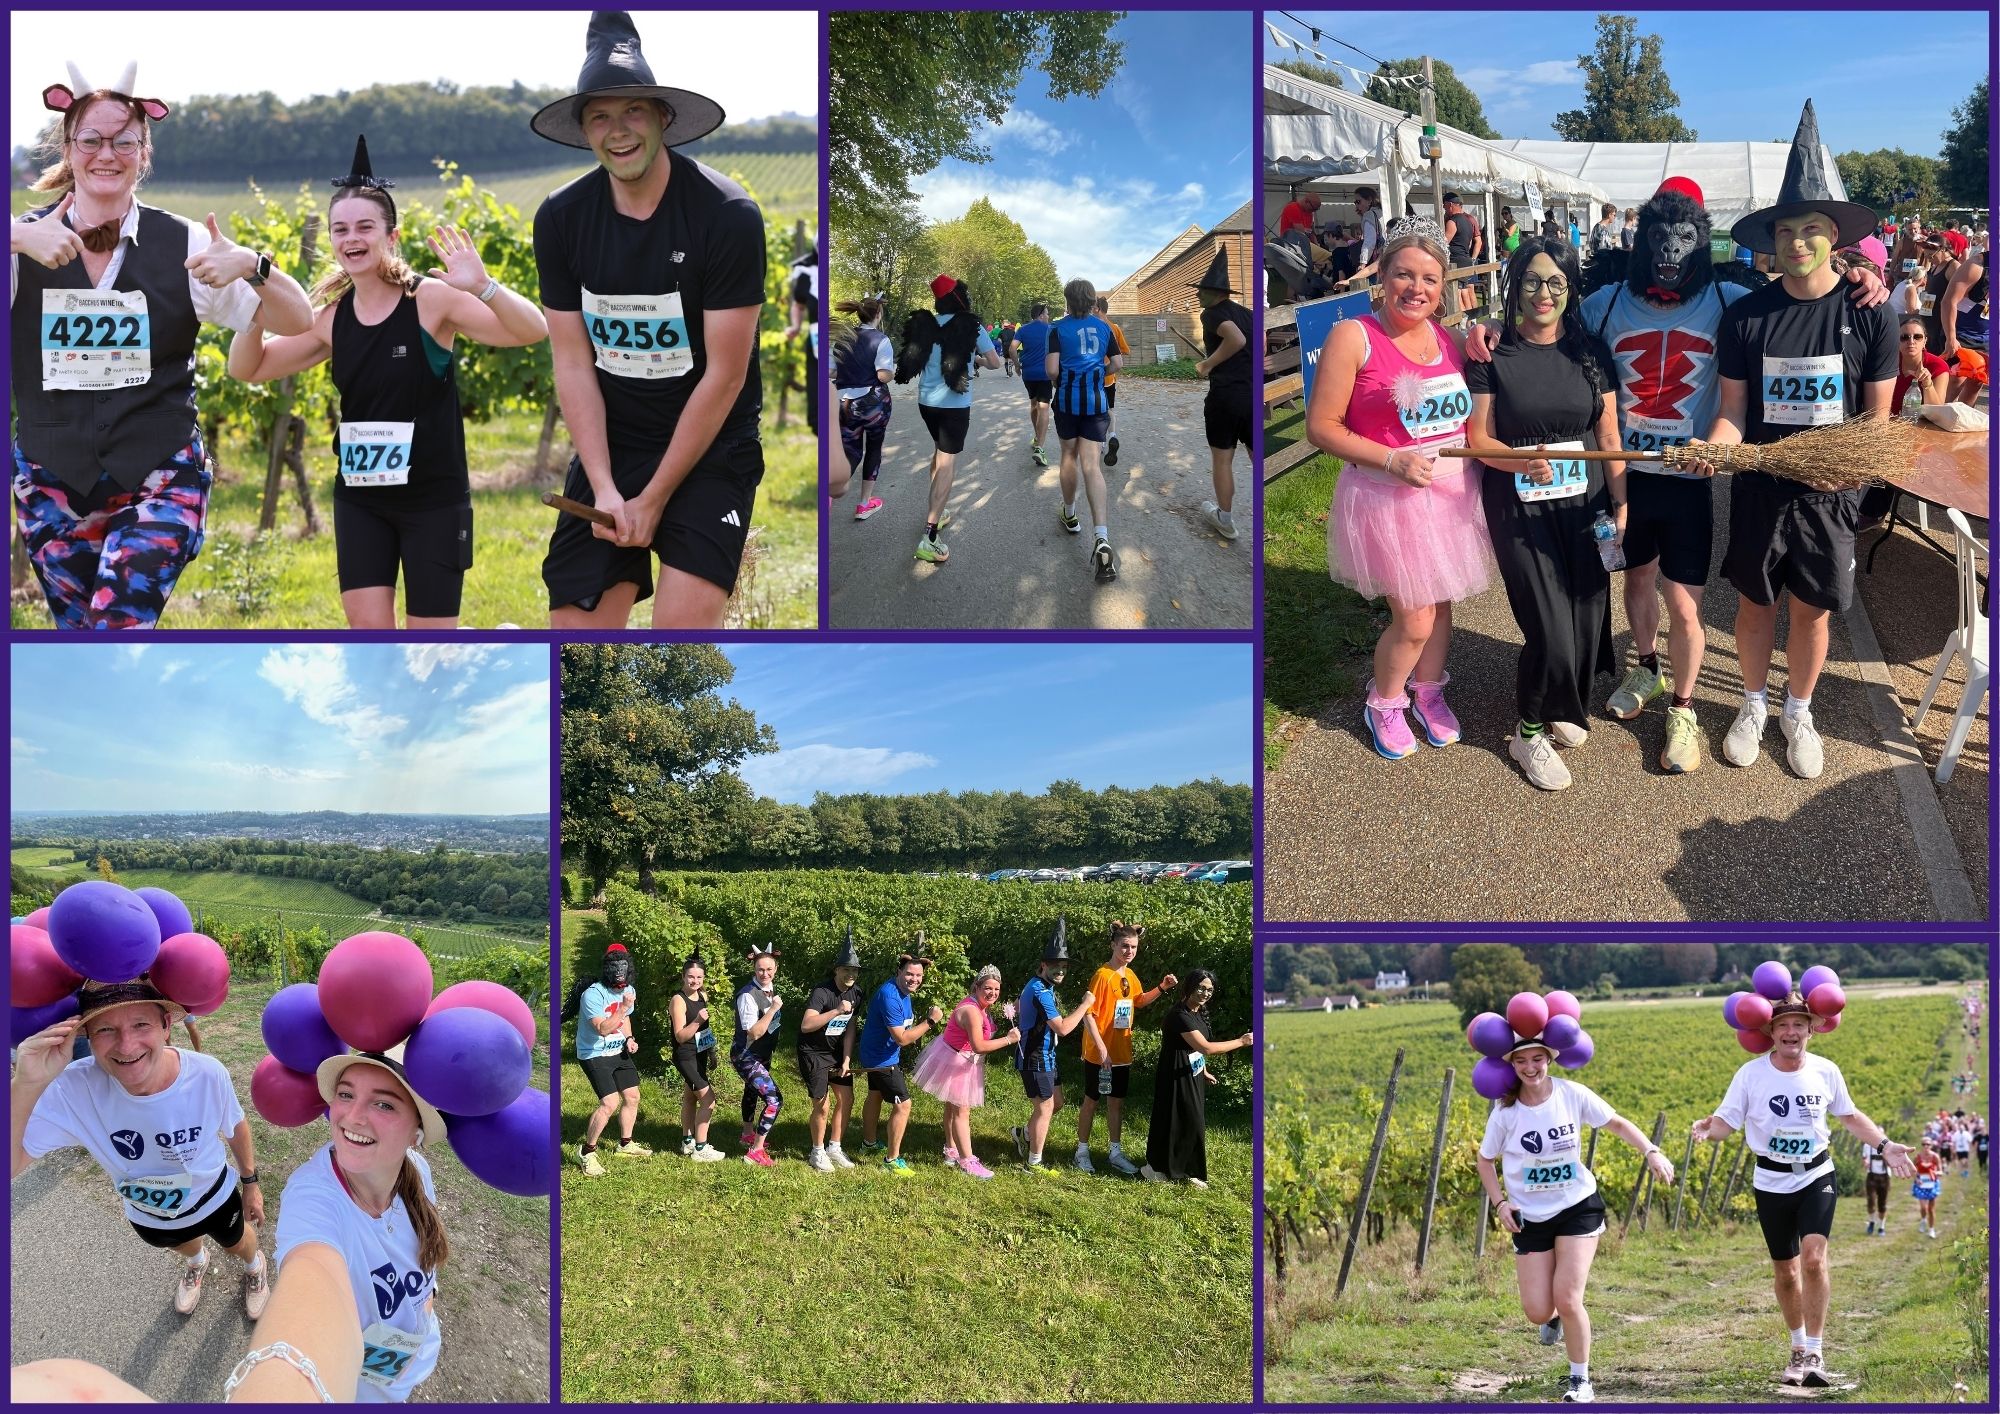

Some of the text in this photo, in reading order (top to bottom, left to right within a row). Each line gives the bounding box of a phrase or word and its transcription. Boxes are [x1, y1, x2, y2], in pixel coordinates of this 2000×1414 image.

[100, 299, 115, 307] WINE
[632, 304, 647, 312] WINE
[48, 316, 141, 347] 4222
[592, 317, 680, 350] 4256
[1077, 327, 1100, 355] 15
[124, 376, 145, 385] 4222
[1768, 377, 1837, 402] 4256
[345, 444, 404, 471] 4276
[1520, 460, 1582, 488] 414
[830, 1020, 848, 1028] 425
[1795, 1095, 1822, 1107] QEF
[154, 1126, 203, 1149] QEF
[1769, 1137, 1811, 1155] 4292
[1527, 1164, 1573, 1183] 4293
[119, 1185, 184, 1210] 4292
